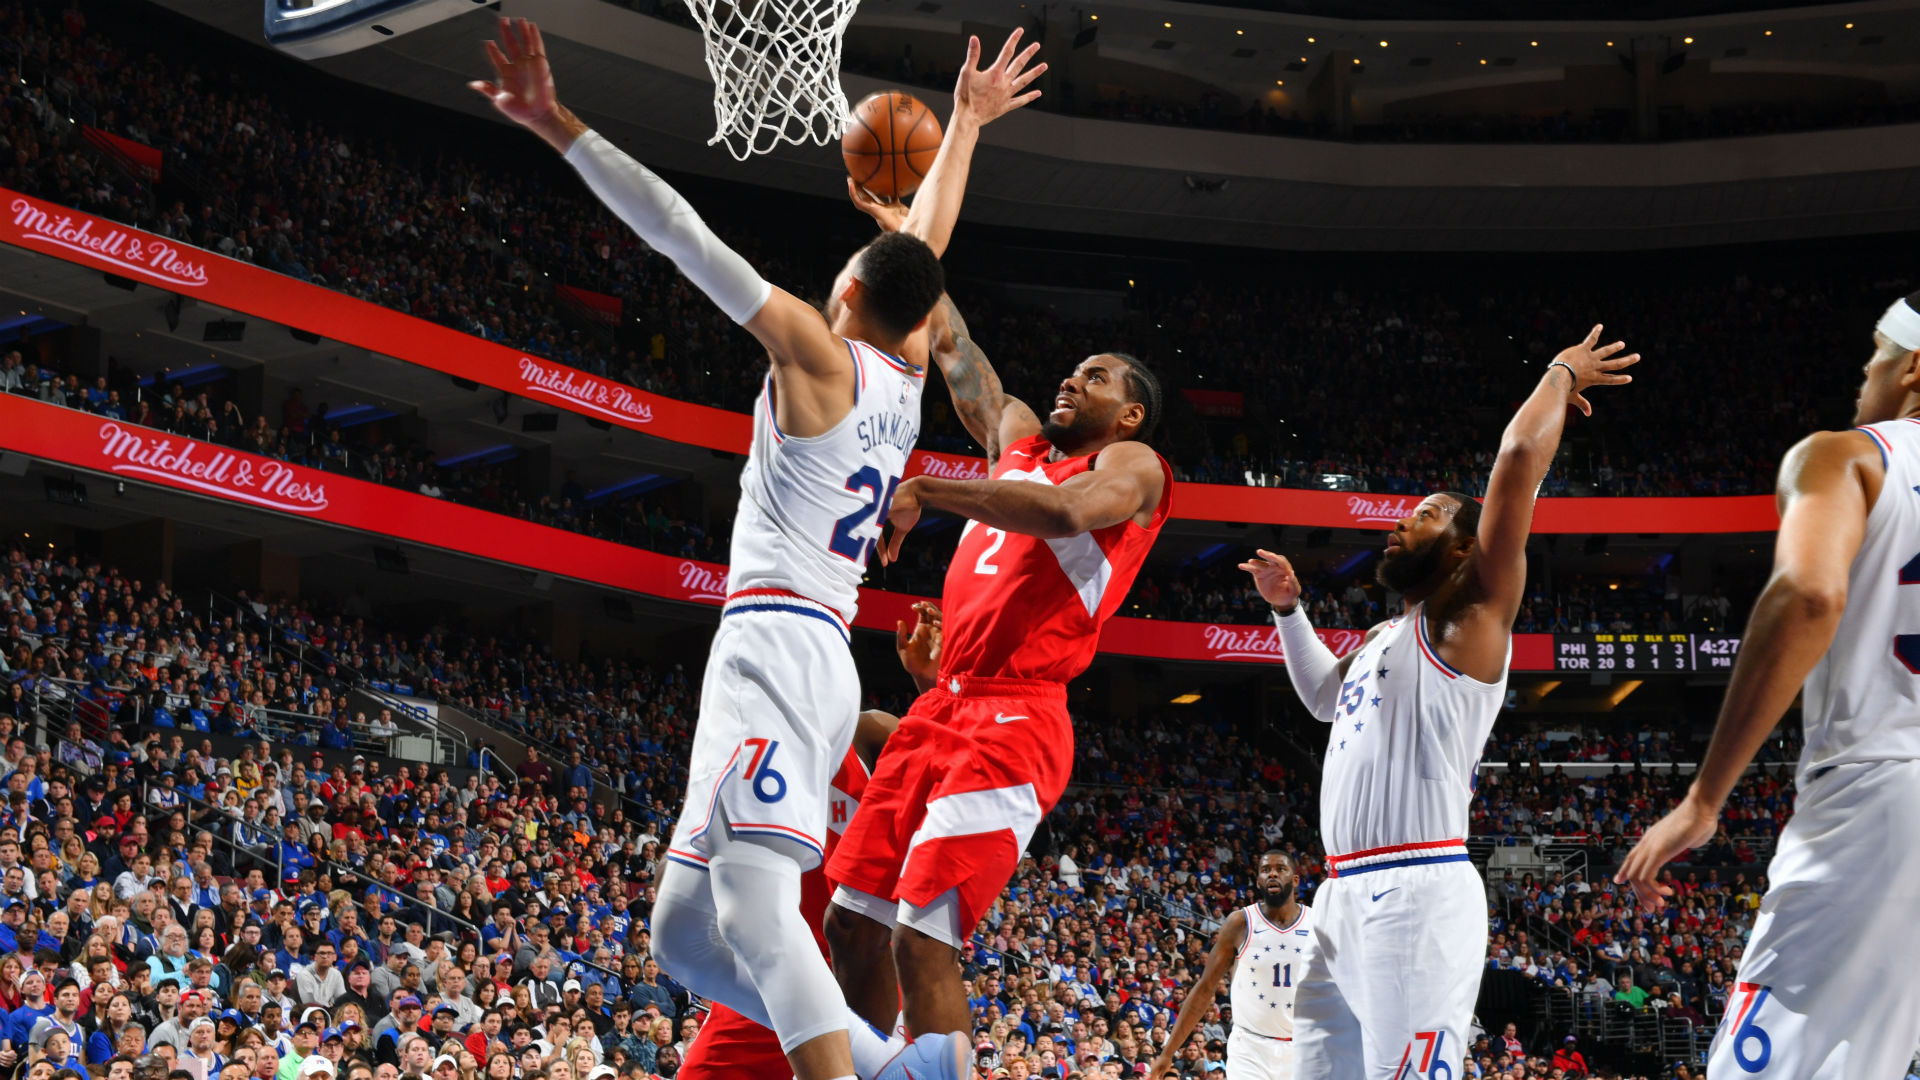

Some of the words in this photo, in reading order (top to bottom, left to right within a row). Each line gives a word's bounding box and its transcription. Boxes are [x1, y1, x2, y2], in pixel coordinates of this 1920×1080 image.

[11, 199, 128, 256] Mitchell
[125, 238, 144, 261] &
[148, 242, 206, 280] Ness
[519, 358, 598, 400] Mitchell
[595, 386, 610, 404] &
[611, 387, 652, 418] Ness
[857, 411, 918, 460] SIMMON
[99, 422, 235, 483] Mitchell
[232, 459, 256, 487] &
[259, 461, 326, 504] Ness
[921, 455, 988, 480] Mitche
[1347, 496, 1414, 519] Mitche
[974, 526, 1007, 575] 2
[1204, 625, 1284, 651] Mitch
[1560, 643, 1587, 655] PHI
[1597, 643, 1615, 655] 20
[1624, 643, 1635, 655] 9
[1650, 643, 1658, 655] 1
[1674, 643, 1684, 655] 3
[1619, 634, 1639, 643] AST
[1644, 634, 1663, 643] BLK
[1669, 634, 1688, 643] STL
[1699, 639, 1741, 655] 4:27
[1558, 657, 1590, 670] TOR
[1597, 657, 1615, 670] 20
[1625, 657, 1635, 670] 8
[1651, 657, 1659, 670] 1
[1675, 657, 1685, 670] 3
[1711, 657, 1732, 668] PM
[743, 738, 787, 804] 76
[1272, 962, 1291, 988] 11
[1730, 981, 1773, 1074] 76
[1414, 1030, 1452, 1080] 76
